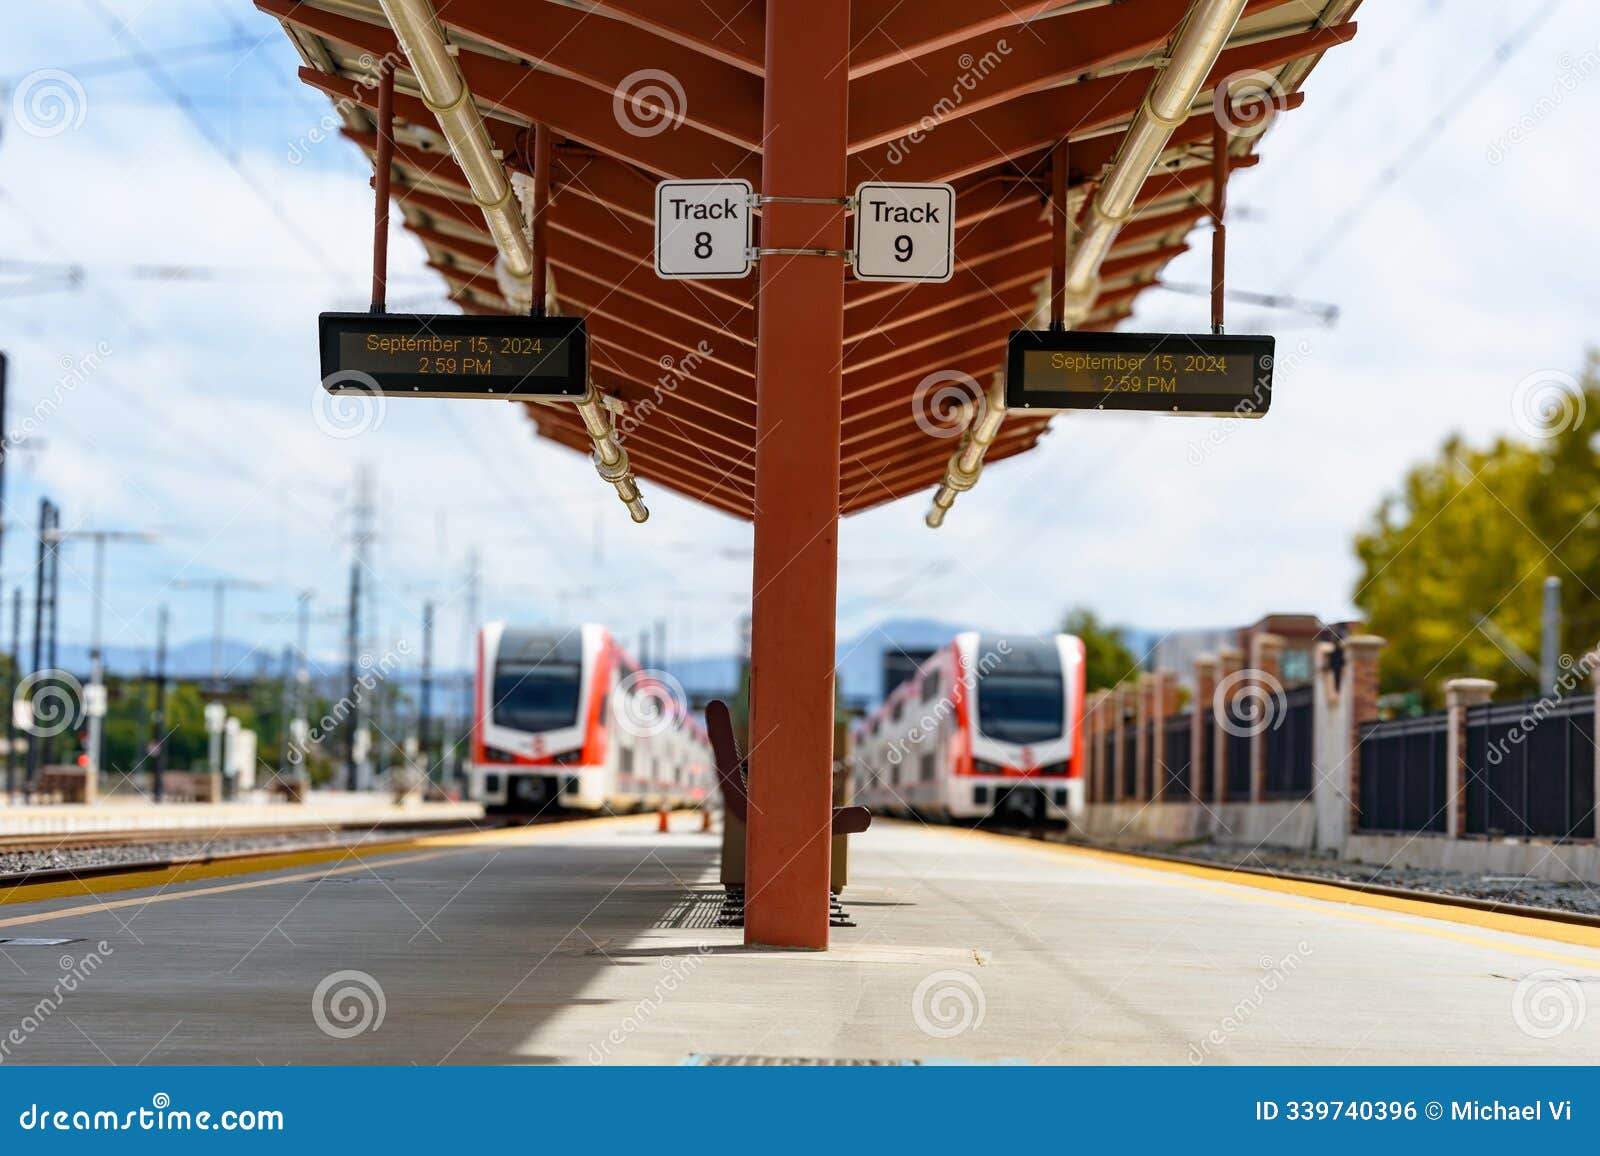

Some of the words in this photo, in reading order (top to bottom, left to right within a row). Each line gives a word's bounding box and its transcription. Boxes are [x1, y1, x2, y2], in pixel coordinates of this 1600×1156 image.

[669, 198, 738, 219] Track
[869, 201, 940, 223] Track
[693, 231, 713, 259] 8
[894, 235, 914, 262] 9
[367, 334, 461, 354] September
[469, 336, 492, 355] 15,
[500, 338, 542, 354] 2024
[418, 357, 457, 374] 2:59
[463, 359, 492, 375] PM
[1051, 353, 1144, 373] September
[1154, 355, 1177, 374] 15,
[1184, 356, 1227, 372] 2024
[1103, 376, 1142, 392] 2:59
[1147, 377, 1177, 393] PM
